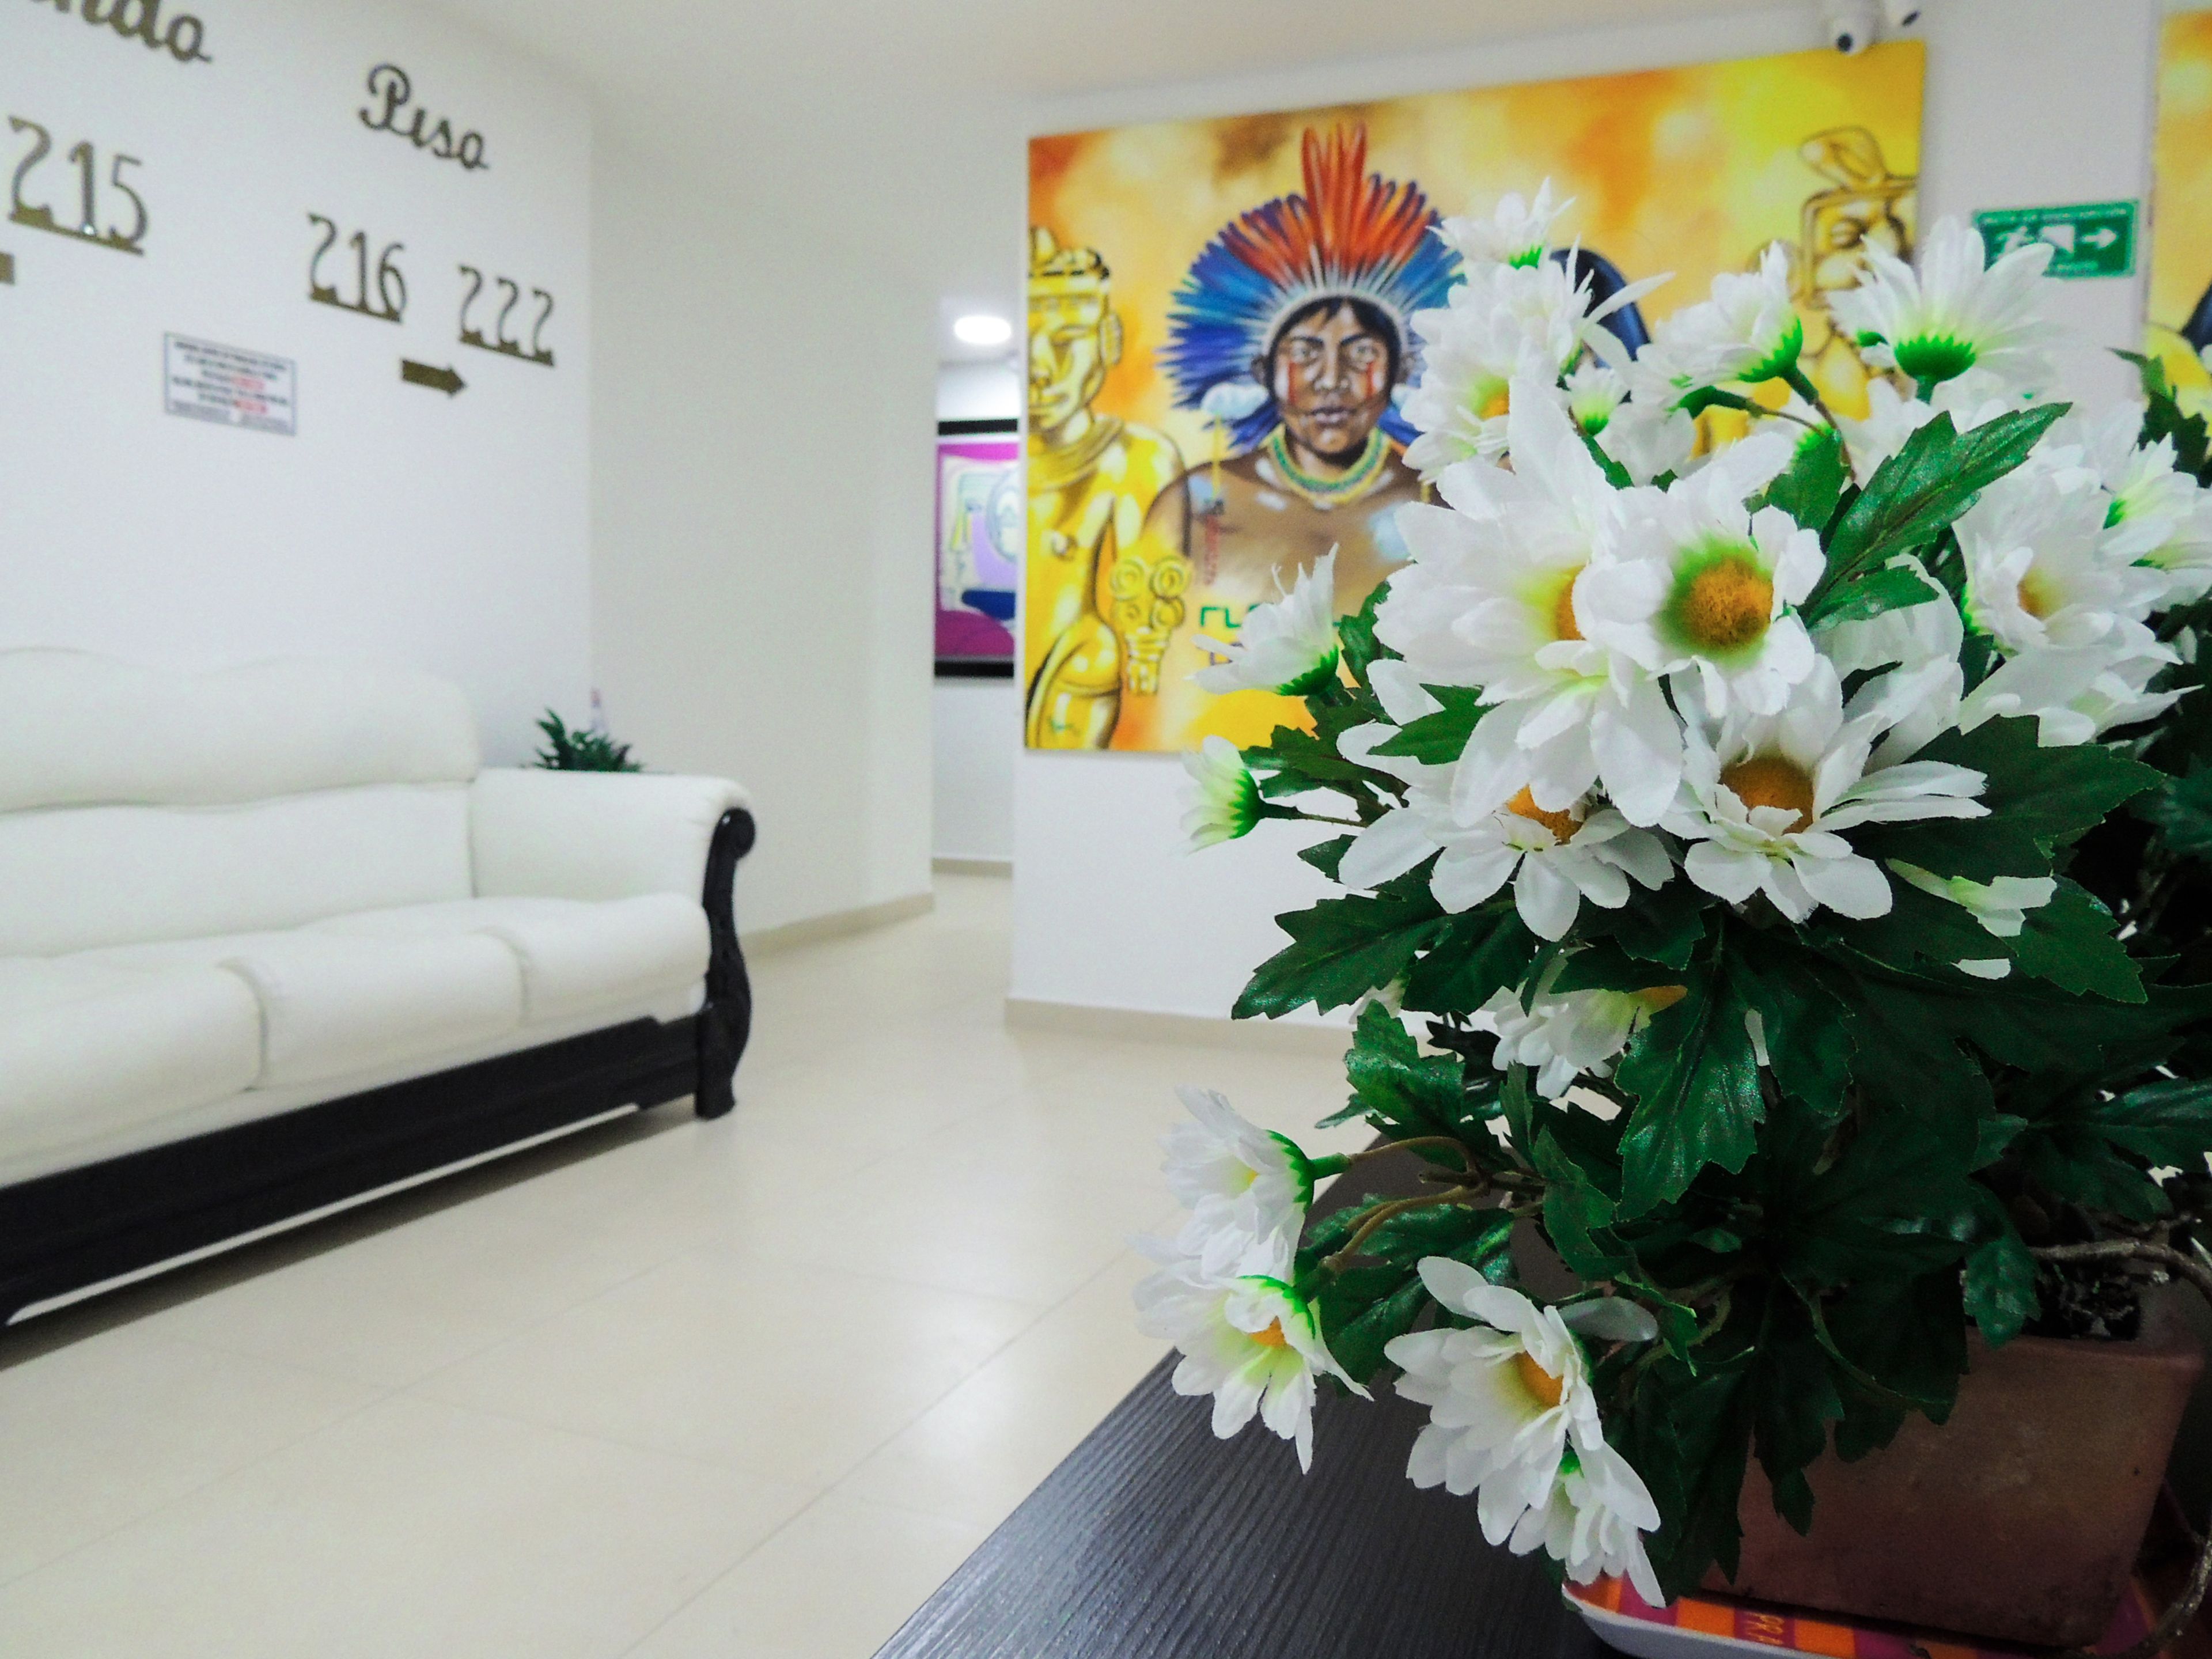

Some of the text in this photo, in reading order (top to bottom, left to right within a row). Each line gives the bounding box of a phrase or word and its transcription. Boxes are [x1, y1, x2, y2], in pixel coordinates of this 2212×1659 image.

[9, 116, 147, 255] 215
[358, 62, 488, 171] Piso
[308, 213, 555, 367] 216 222
